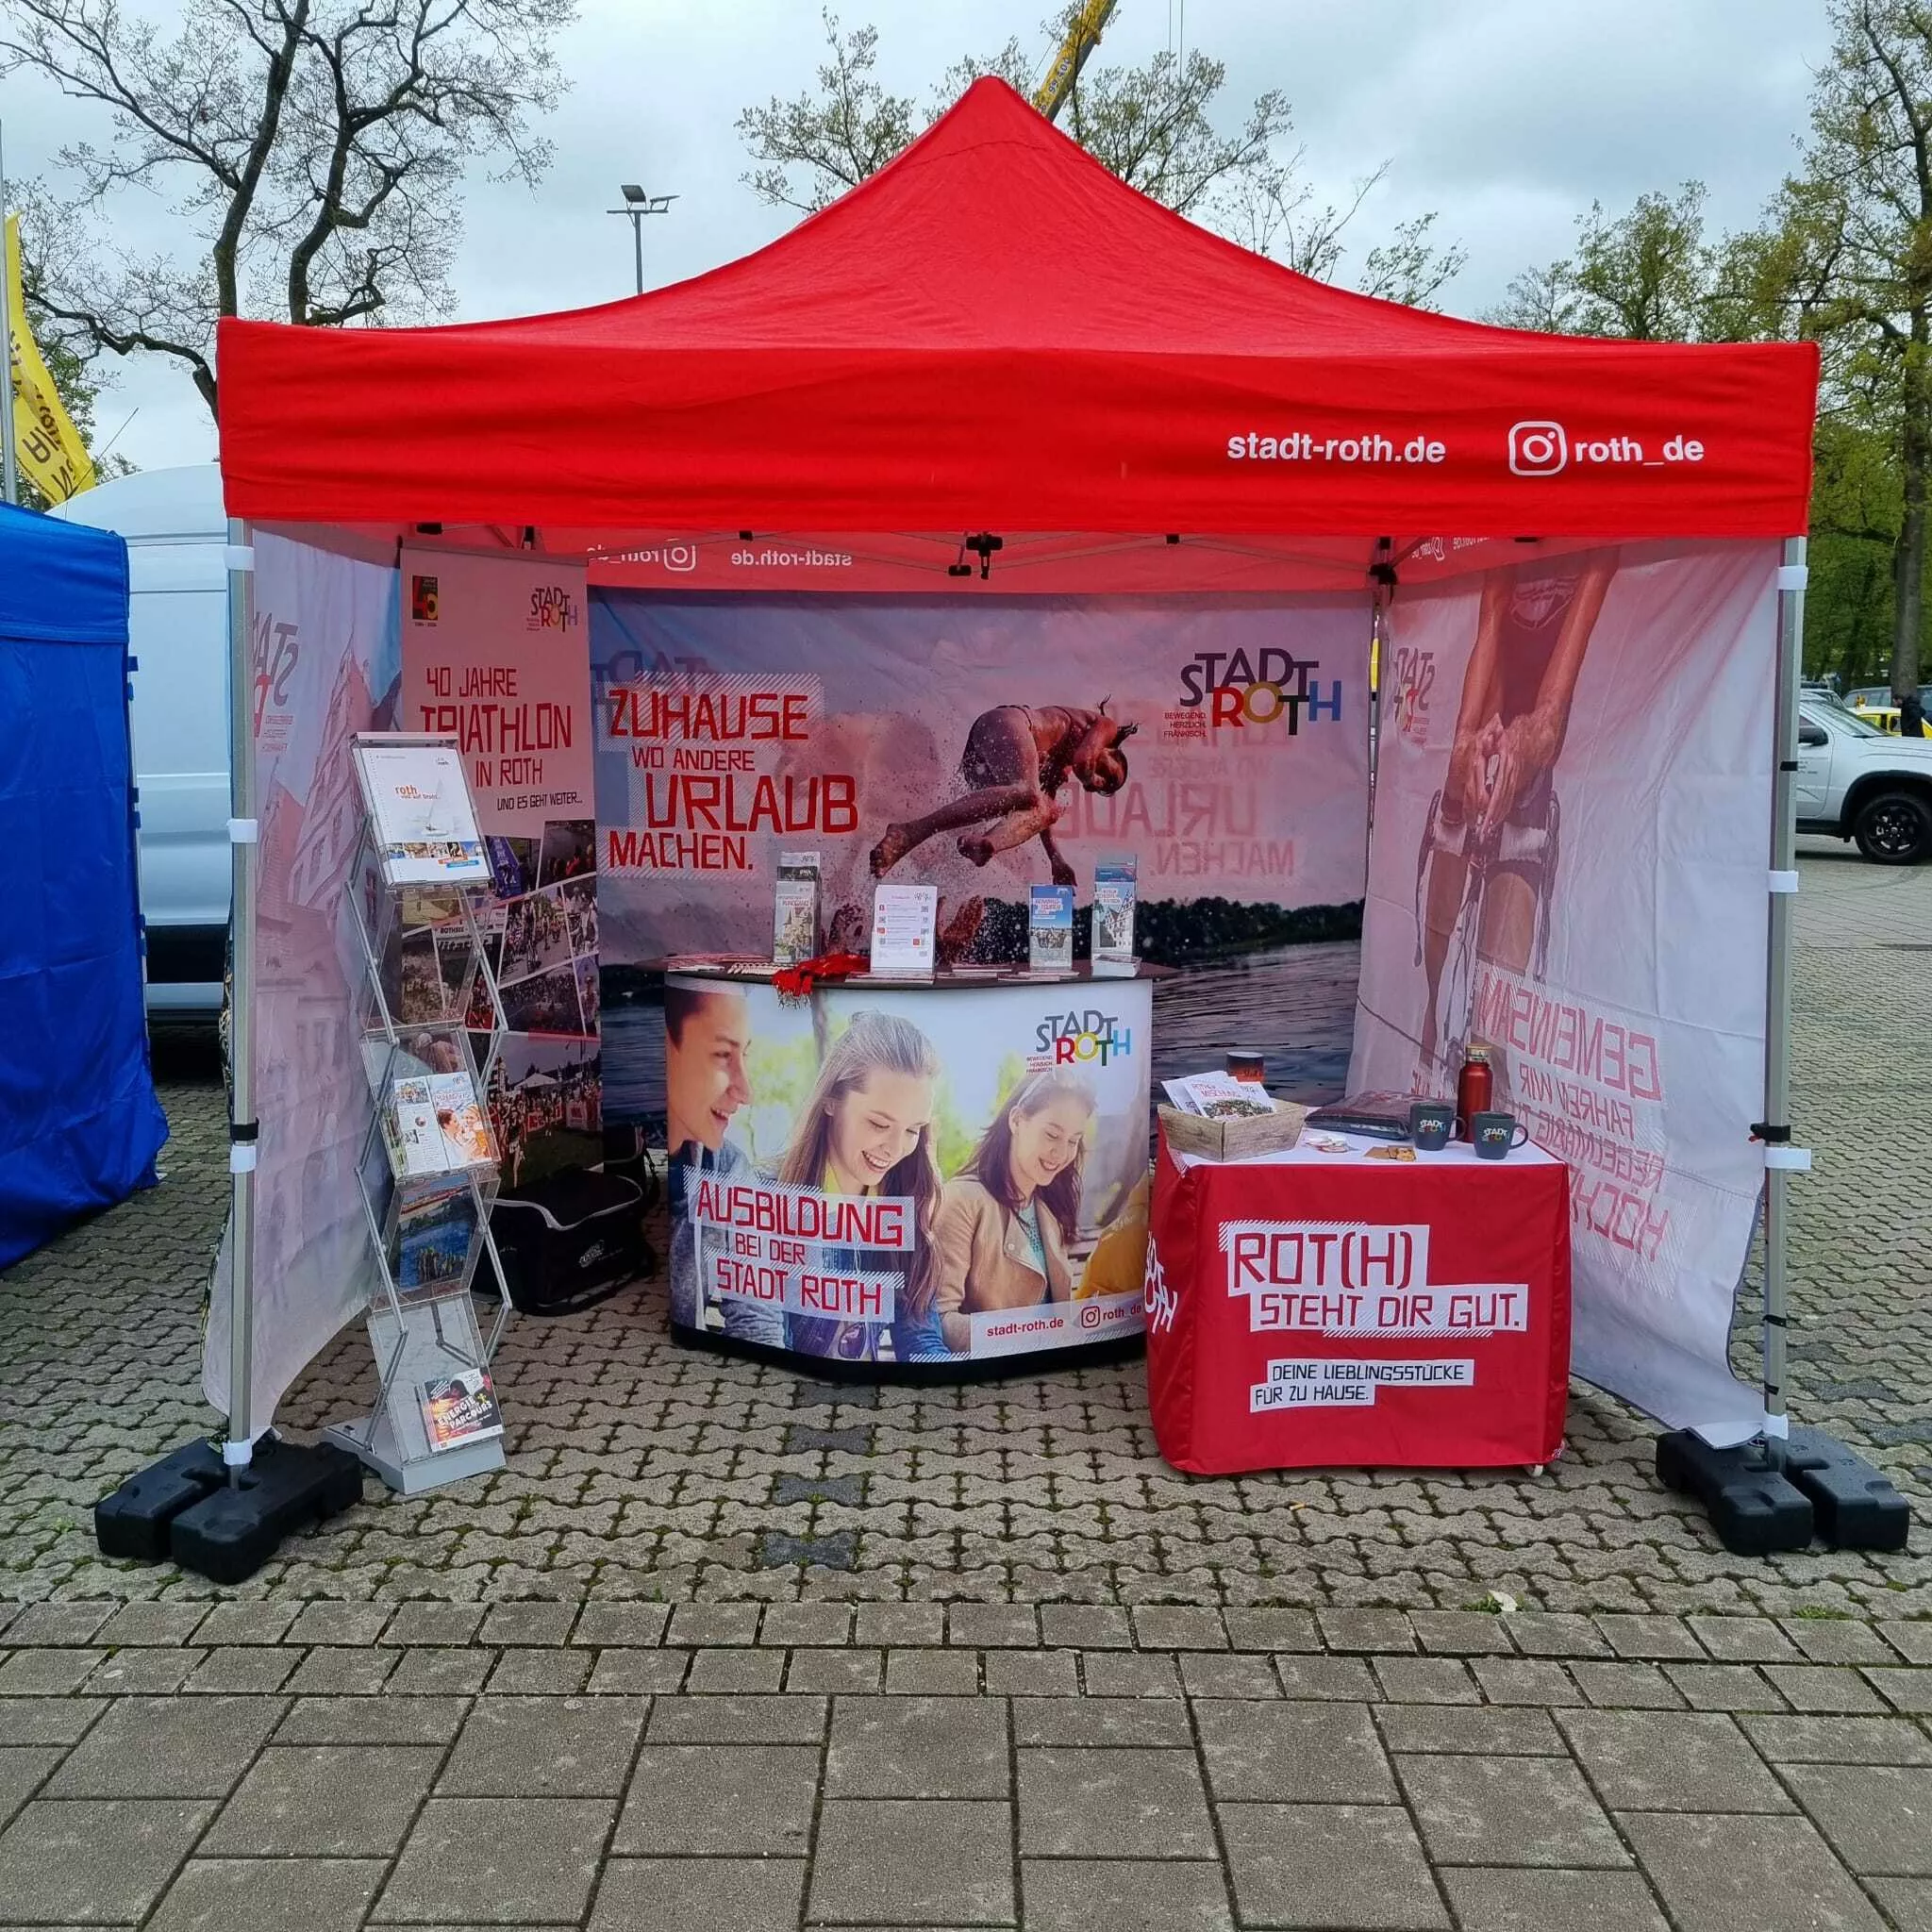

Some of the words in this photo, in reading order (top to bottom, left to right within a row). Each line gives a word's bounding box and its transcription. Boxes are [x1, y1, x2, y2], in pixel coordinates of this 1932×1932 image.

[1228, 433, 1446, 462] stadt-roth.de
[1574, 435, 1705, 465] roth_de
[531, 586, 571, 616] STADT
[426, 667, 451, 697] 40
[458, 667, 518, 698] JAHRE
[1179, 646, 1320, 708] STADT
[608, 689, 808, 741] ZUHAUSE
[1212, 680, 1342, 736] ROTH
[420, 702, 572, 756] TRIATHLON
[475, 759, 492, 788] IN
[500, 757, 543, 787] ROTH
[632, 746, 665, 769] WO
[673, 747, 756, 772] ANDERE
[394, 784, 418, 795] roth
[497, 797, 515, 811] UND
[517, 795, 528, 809] ES
[529, 793, 548, 808] GEHT
[645, 773, 859, 834] URLAUB
[608, 830, 754, 870] MACHEN.
[1036, 1009, 1119, 1053] STADT
[1056, 1027, 1131, 1067] ROTH
[697, 1179, 904, 1247] AUSBILDUNG
[735, 1232, 762, 1258] BEI
[769, 1240, 807, 1266] DER
[1234, 1230, 1413, 1291] ROT(H)
[716, 1257, 789, 1304] STADT
[801, 1274, 882, 1316] ROTH
[987, 1317, 1064, 1337] stadt-roth.de
[1259, 1293, 1364, 1327] STEHT
[1377, 1294, 1434, 1328] DIR
[1447, 1292, 1521, 1329] GUT.
[1273, 1364, 1318, 1381] DEINE
[1324, 1364, 1465, 1381] LIEBLINGSSTÜCKE
[438, 1394, 476, 1426] ENERGIE
[1255, 1386, 1283, 1406] FÜR
[1289, 1385, 1307, 1402] ZU
[1313, 1385, 1369, 1401] HAUSE.
[449, 1401, 492, 1429] PARCOURS
